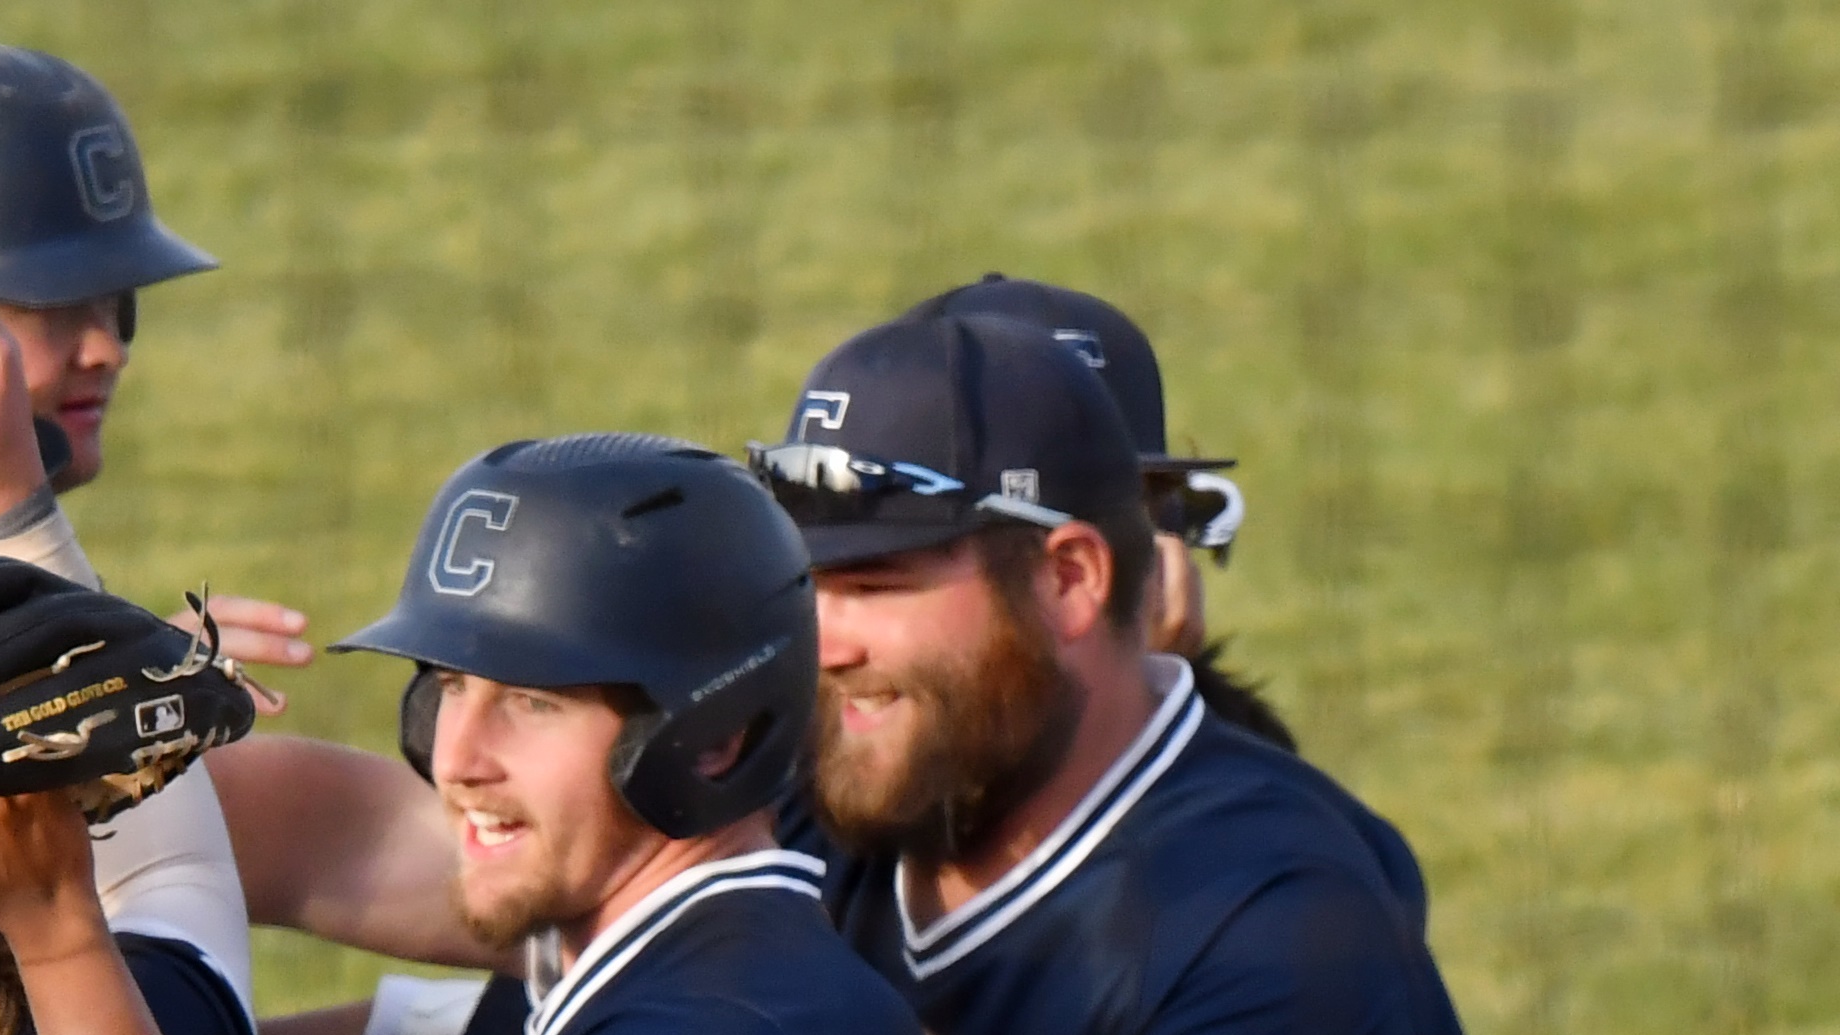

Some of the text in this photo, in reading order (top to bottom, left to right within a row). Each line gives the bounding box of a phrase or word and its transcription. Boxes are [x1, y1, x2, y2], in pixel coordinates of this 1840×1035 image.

[69, 124, 134, 222] C
[428, 489, 519, 596] C
[0, 709, 32, 732] THE
[30, 697, 67, 721] GOLD
